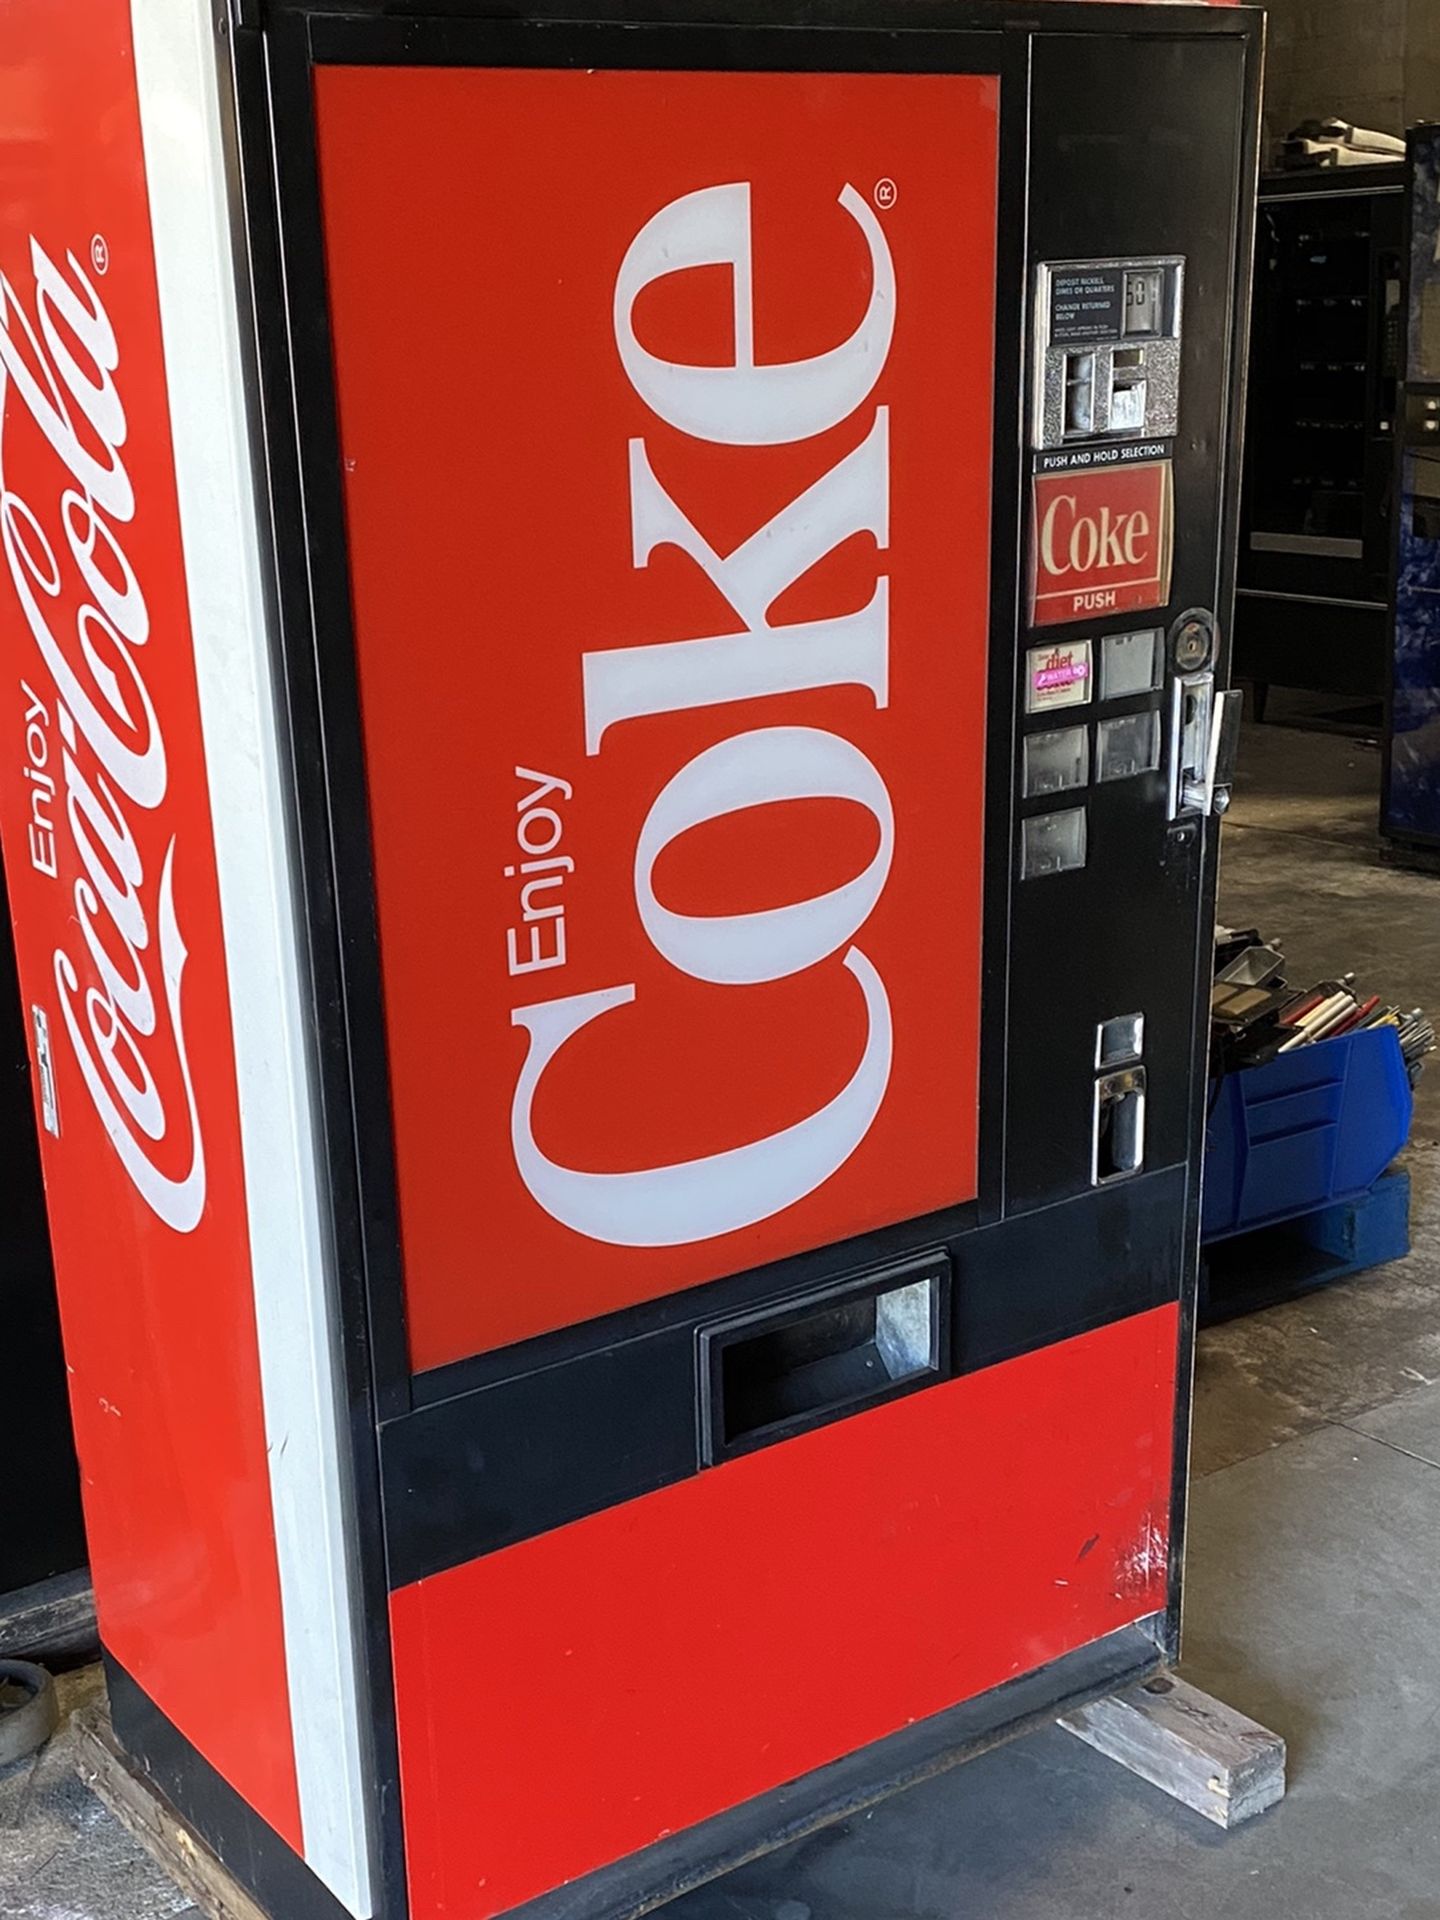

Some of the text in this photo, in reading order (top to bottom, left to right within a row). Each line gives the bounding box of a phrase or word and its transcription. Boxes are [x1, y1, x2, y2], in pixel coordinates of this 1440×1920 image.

[1074, 286, 1084, 295] OR
[1084, 284, 1115, 294] QUARTERS
[1054, 300, 1111, 312] CHANGE RETURNED
[1055, 312, 1076, 321] BELOW
[1043, 444, 1165, 468] PUSH AND HOLD SELECTION
[1041, 494, 1150, 576] Coke
[1073, 591, 1116, 612] PUSH
[1046, 650, 1073, 670] diet
[510, 181, 898, 1248] Coke
[0, 234, 207, 1234] Coca-Cola
[20, 679, 58, 879] Enjoy
[504, 765, 576, 977] Enjoy
